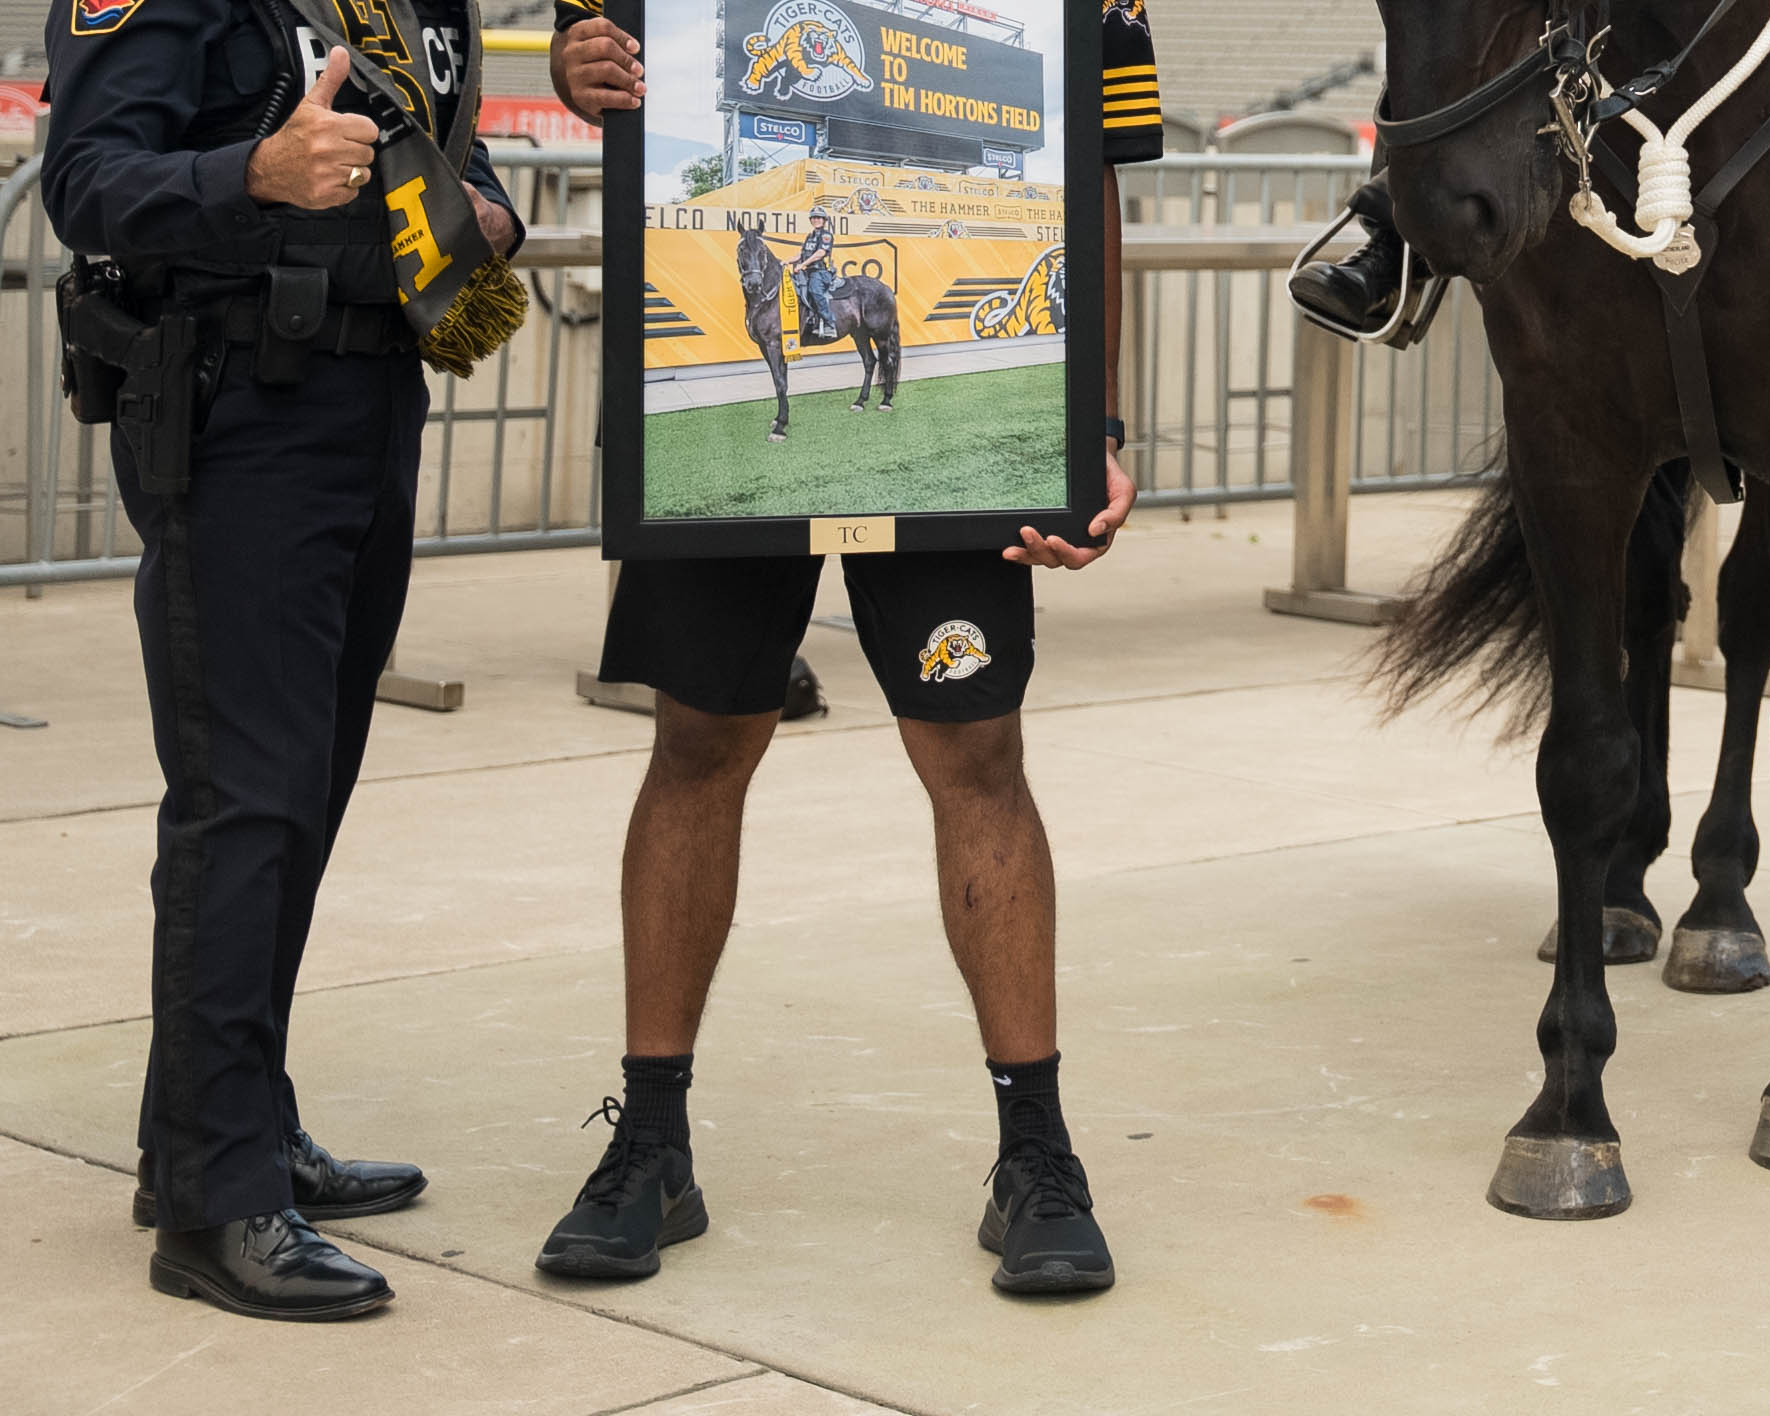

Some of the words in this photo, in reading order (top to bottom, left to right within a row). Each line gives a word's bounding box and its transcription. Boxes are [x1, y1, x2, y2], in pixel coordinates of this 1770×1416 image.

[773, 2, 856, 44] TIGER-CATS
[880, 26, 968, 70] WELCOME
[880, 54, 907, 82] TO
[801, 78, 850, 95] FOOTBALL
[881, 82, 915, 111] TIM
[920, 90, 998, 126] HORTONS
[1001, 105, 1041, 132] FIELD
[759, 122, 800, 137] STELCO
[839, 175, 880, 187] STELCO
[963, 185, 995, 197] STELCO
[911, 200, 936, 214] THE
[940, 202, 990, 217] HAMMER
[1026, 208, 1046, 220] THE
[726, 210, 797, 234] NORTH
[837, 525, 869, 544] TC
[932, 624, 980, 644] TIGER-CATS
